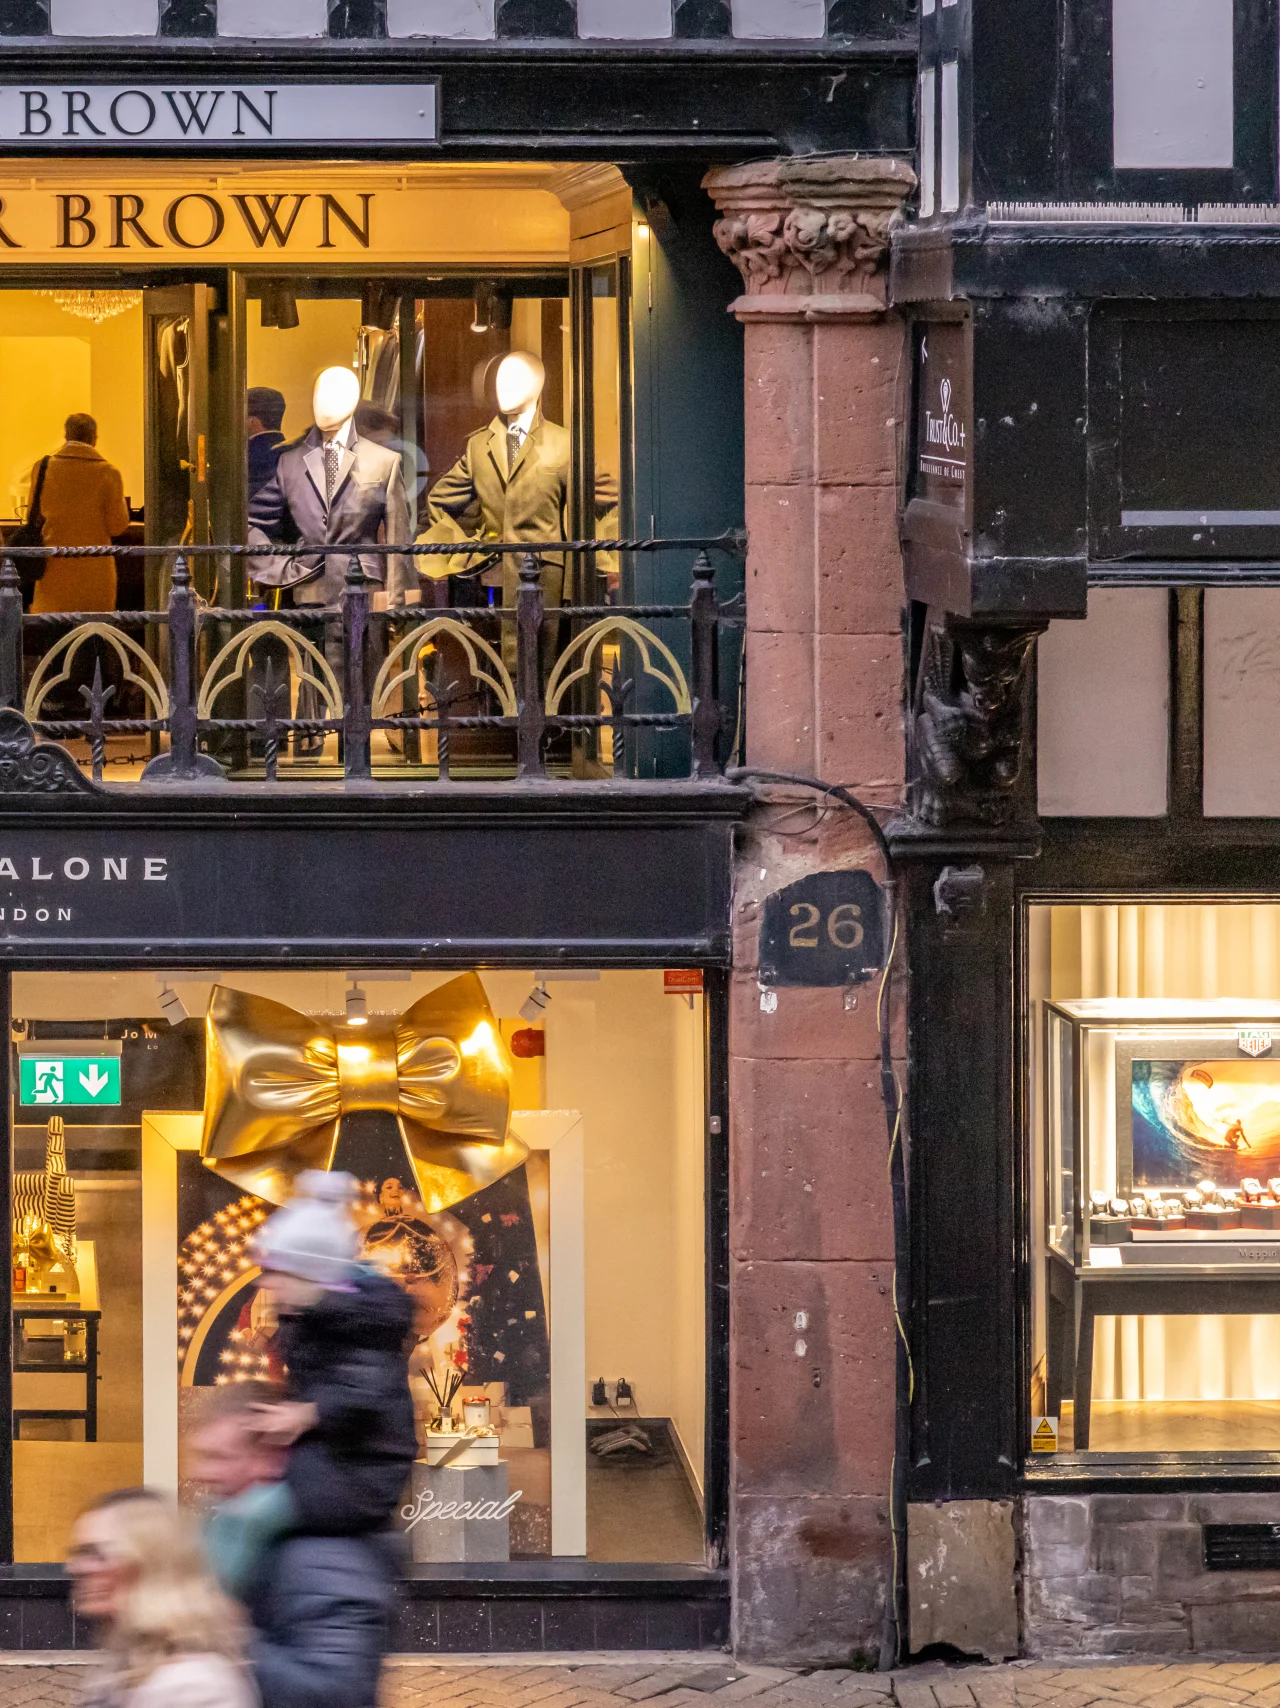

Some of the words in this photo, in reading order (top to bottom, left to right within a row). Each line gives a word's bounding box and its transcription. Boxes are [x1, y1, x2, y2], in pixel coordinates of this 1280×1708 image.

[19, 90, 278, 136] BROWN
[54, 193, 376, 249] BROWN
[789, 902, 864, 949] 26
[400, 1489, 523, 1533] Special
